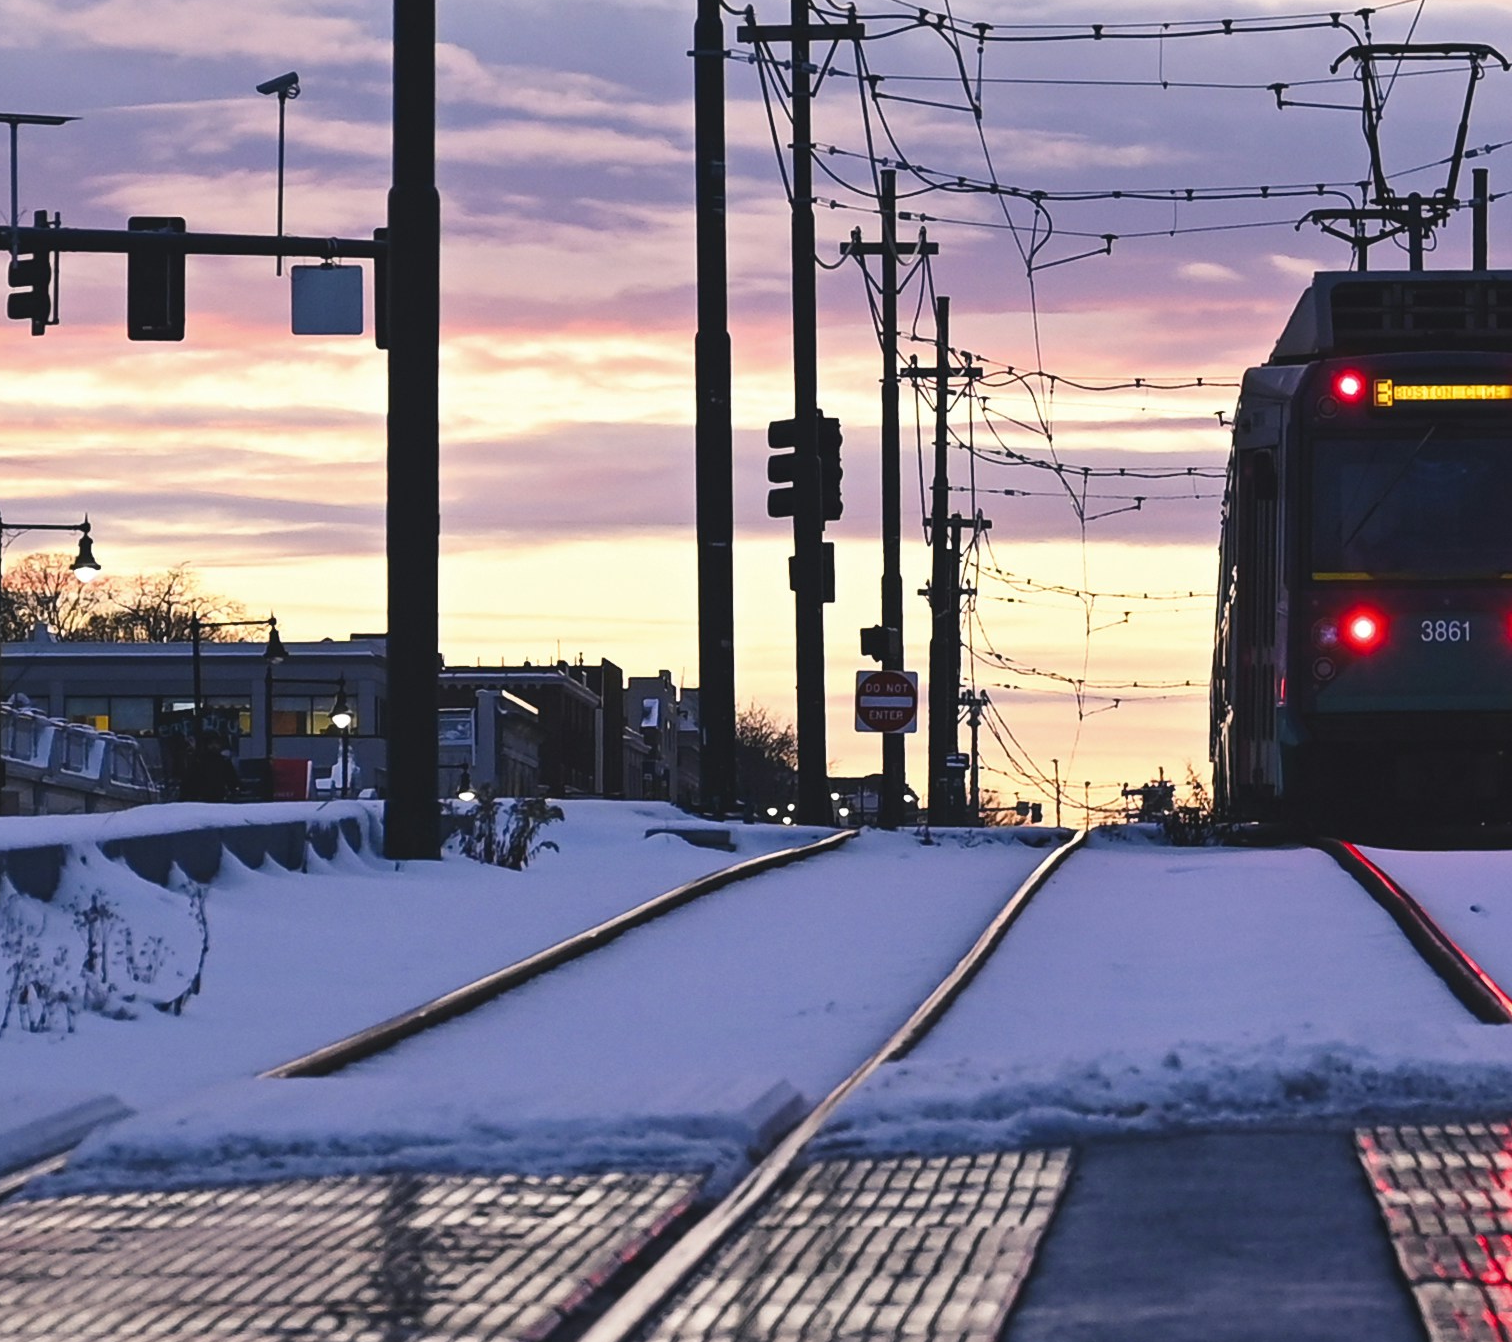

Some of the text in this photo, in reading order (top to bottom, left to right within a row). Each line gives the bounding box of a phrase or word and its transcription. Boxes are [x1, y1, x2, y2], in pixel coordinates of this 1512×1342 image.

[1395, 386, 1454, 398] BOSTON
[1421, 620, 1471, 642] 3861
[866, 683, 909, 693] DO NOT
[869, 710, 904, 720] ENTER
